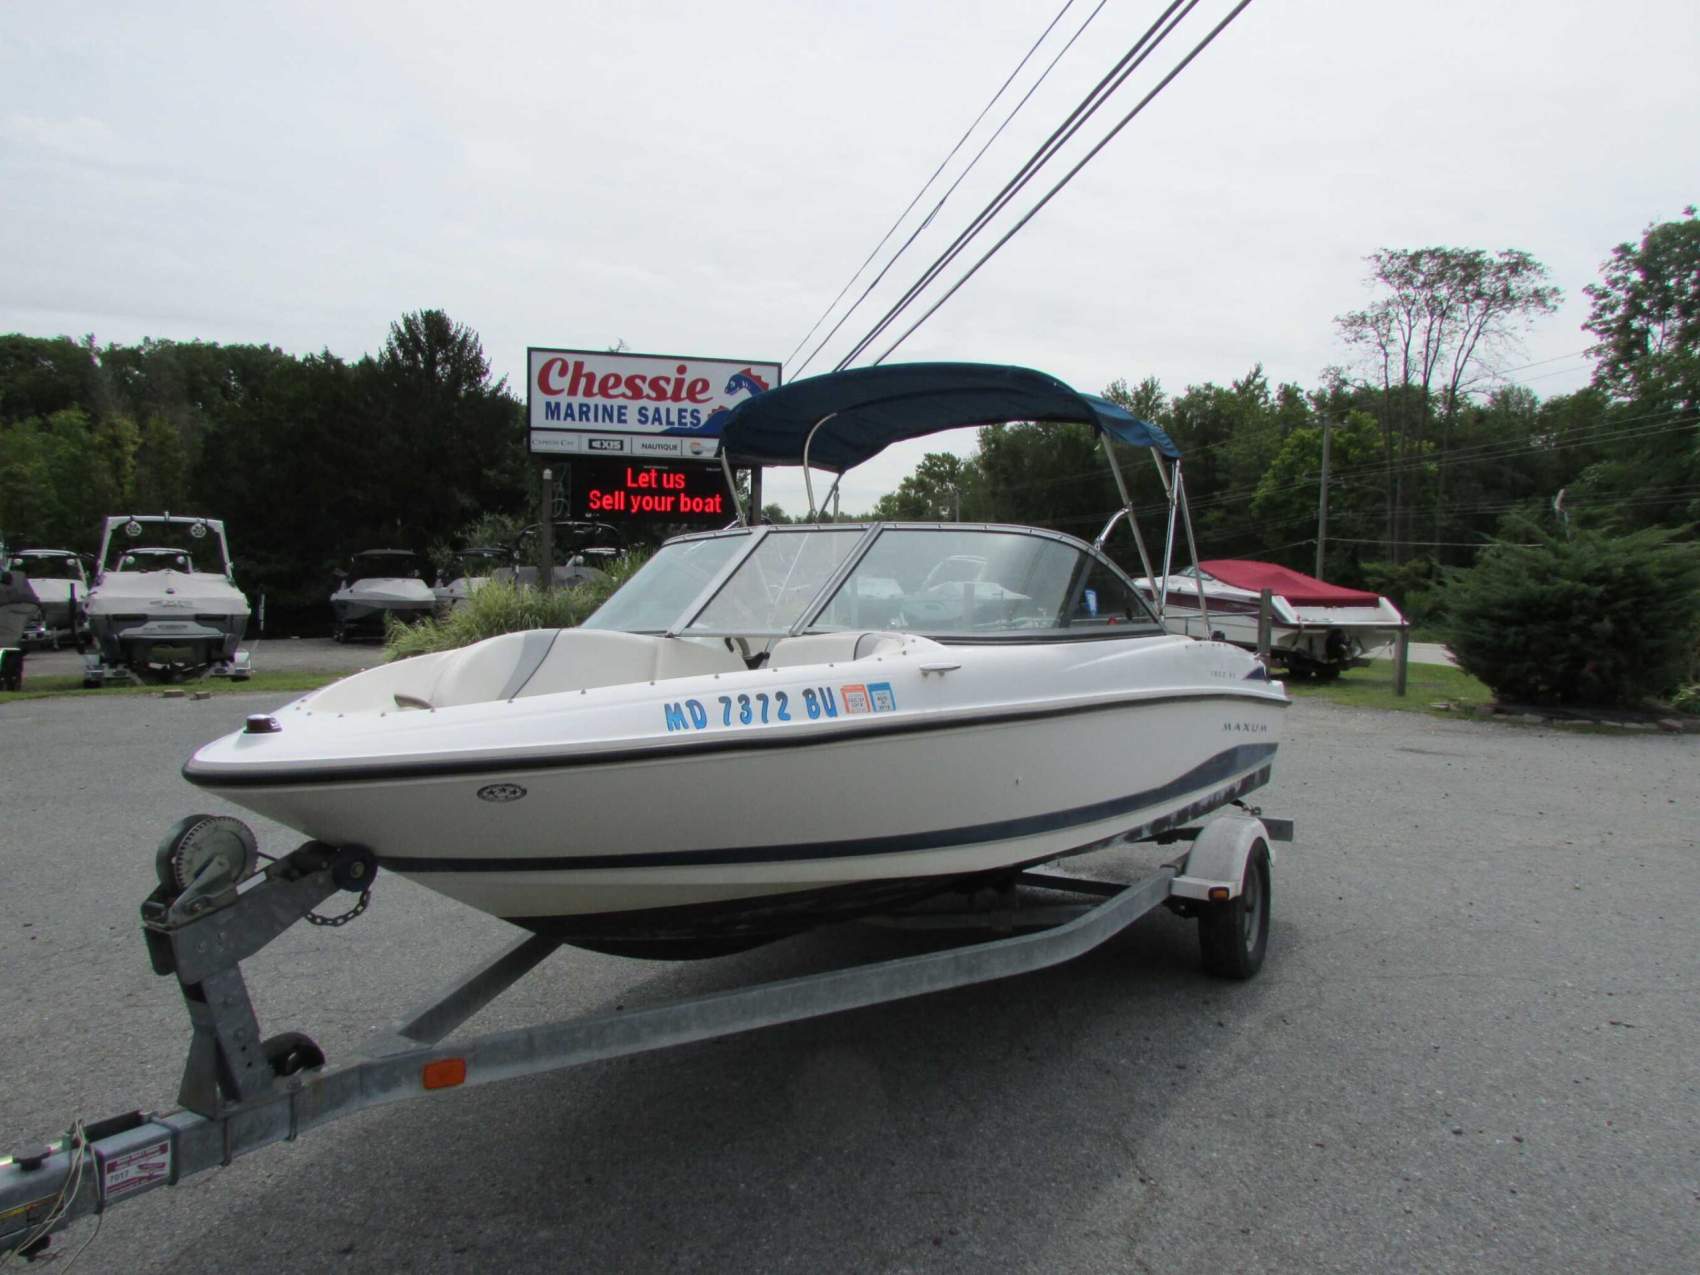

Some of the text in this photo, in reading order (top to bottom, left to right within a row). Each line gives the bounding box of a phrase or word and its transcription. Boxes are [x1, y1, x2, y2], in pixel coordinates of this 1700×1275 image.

[537, 357, 714, 404] Chessie
[545, 401, 702, 427] MARINE SALES
[641, 442, 678, 451] NAUTIQUE
[626, 467, 686, 489] Let us
[589, 490, 722, 513] Sell your boat
[664, 699, 708, 731] MD
[718, 691, 791, 727] 7372
[802, 686, 839, 720] BU
